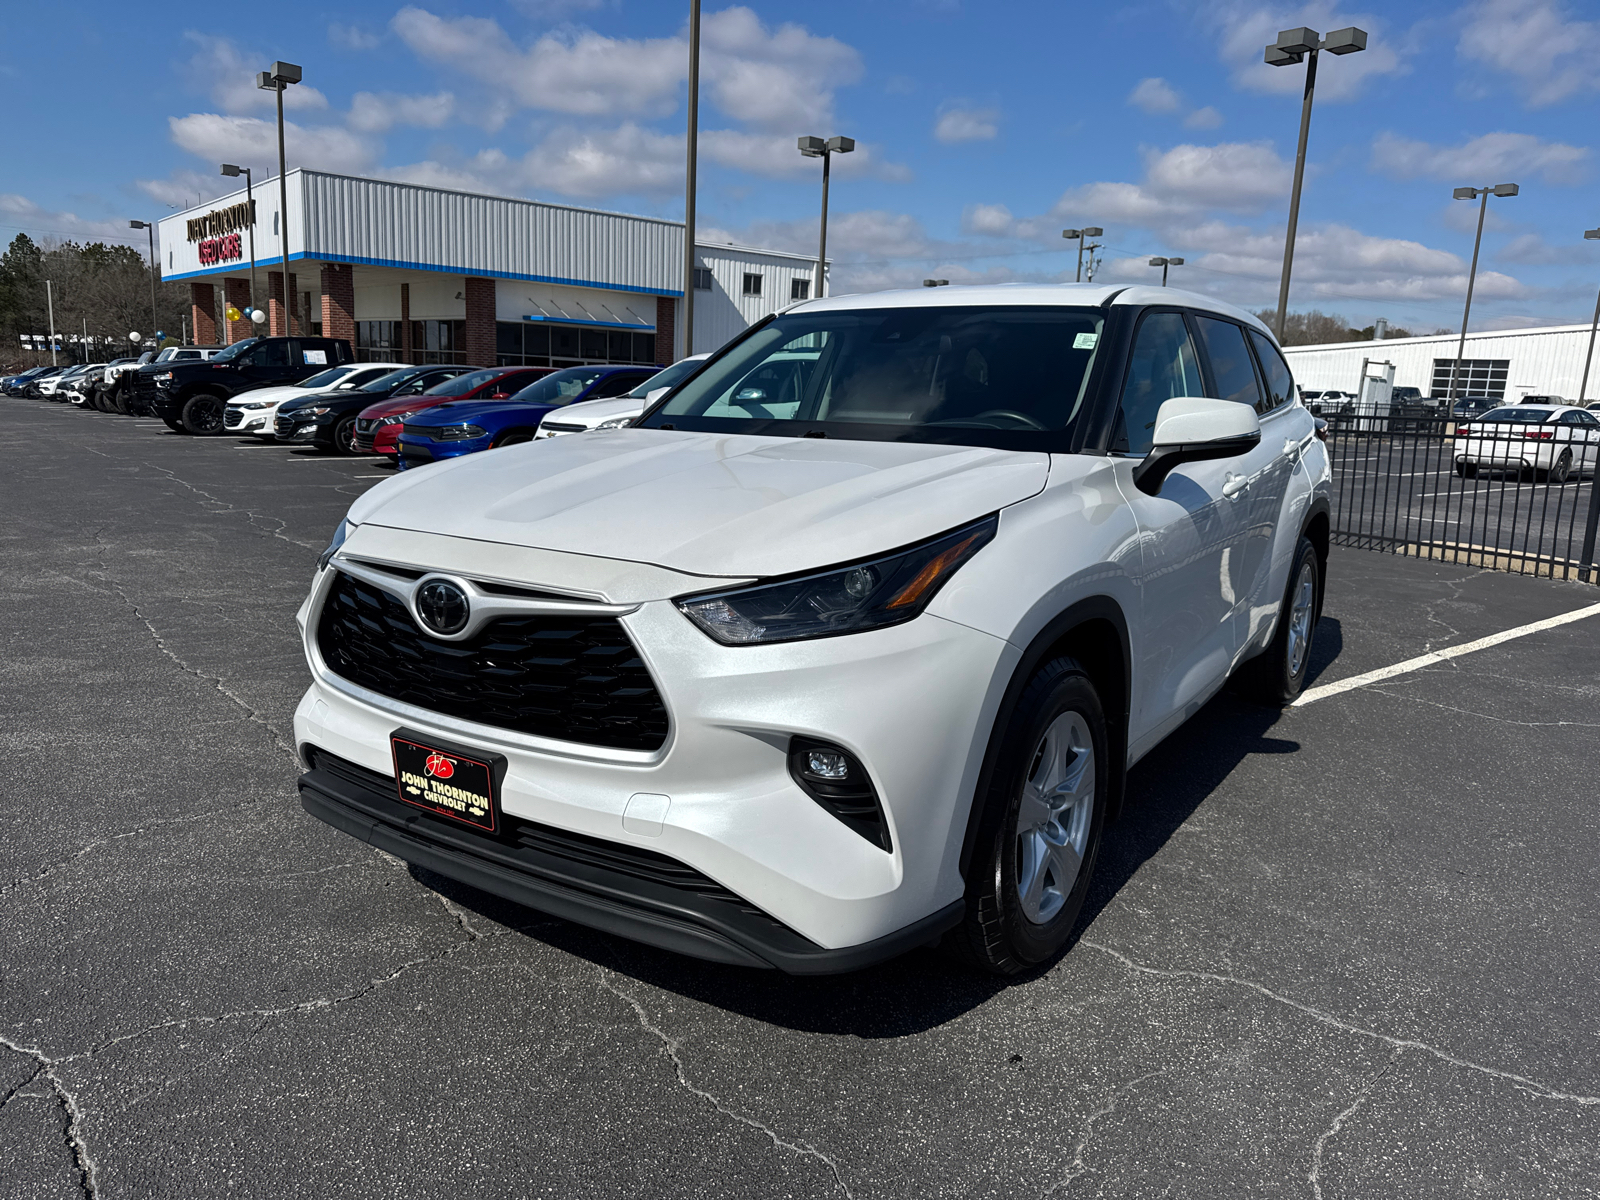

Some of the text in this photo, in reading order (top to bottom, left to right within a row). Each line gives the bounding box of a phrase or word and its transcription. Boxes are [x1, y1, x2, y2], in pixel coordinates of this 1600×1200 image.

[186, 216, 207, 242] JOHN
[198, 233, 241, 264] USED CARS
[401, 771, 489, 810] JOHN THORNTON
[423, 790, 466, 812] CHEVROLET
